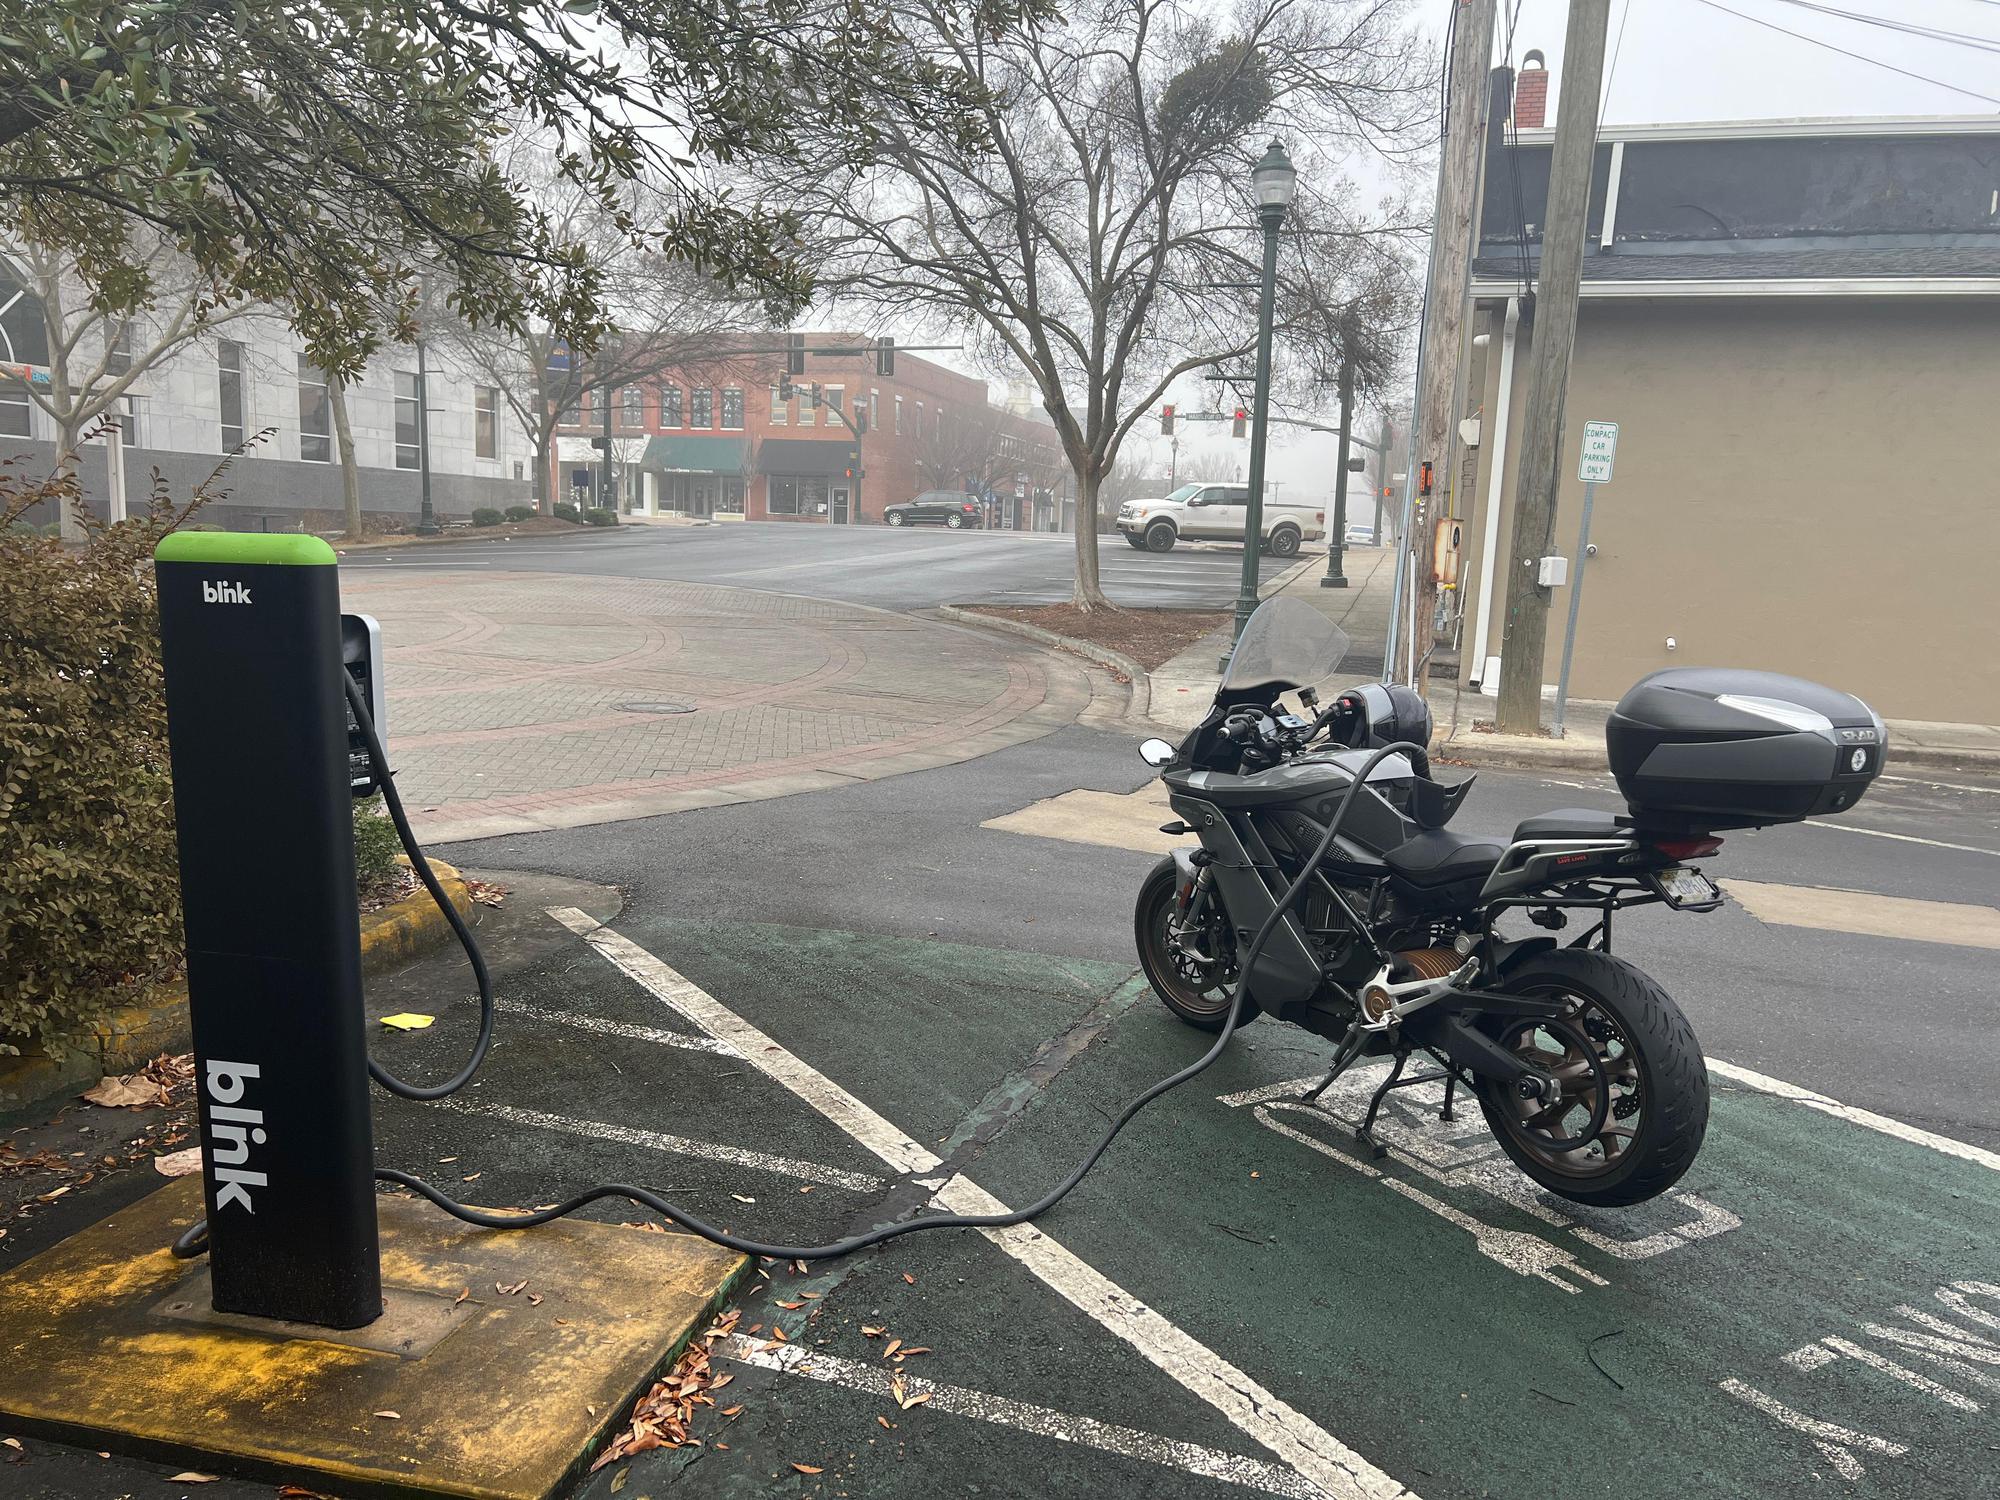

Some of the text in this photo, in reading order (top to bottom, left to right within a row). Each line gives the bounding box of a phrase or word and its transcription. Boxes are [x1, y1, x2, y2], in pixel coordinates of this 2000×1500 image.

[1586, 429, 1615, 439] COMPACT
[1592, 442, 1606, 450] CAR
[1584, 453, 1611, 463] PARKING
[1587, 465, 1604, 474] ONLY
[202, 580, 253, 604] blink
[206, 1059, 268, 1212] blink
